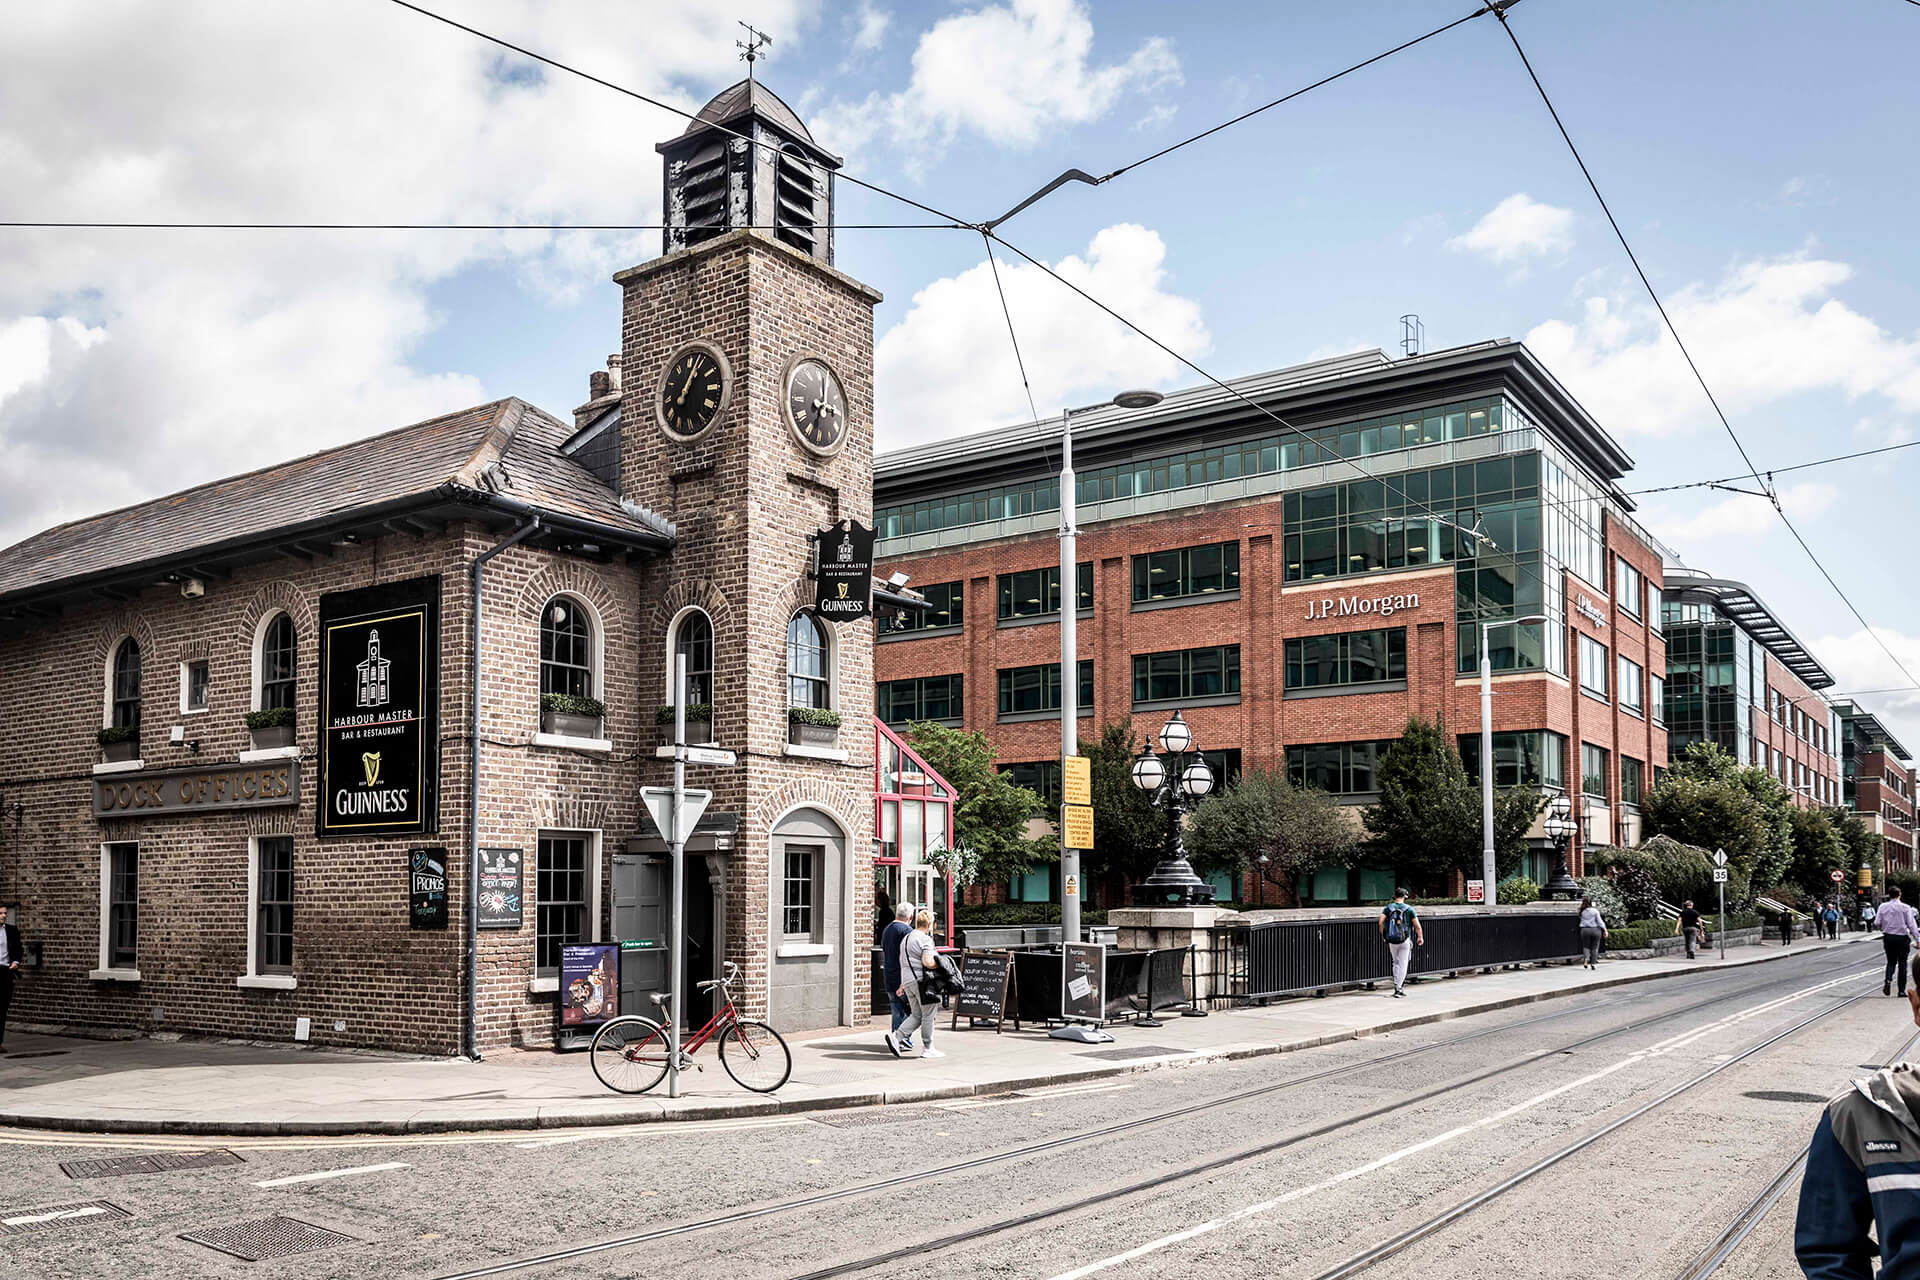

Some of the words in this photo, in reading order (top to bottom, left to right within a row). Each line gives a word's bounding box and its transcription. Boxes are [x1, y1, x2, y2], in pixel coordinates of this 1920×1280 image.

[821, 599, 864, 612] GUINNESS
[1304, 593, 1420, 620] J.P.Morgan
[334, 713, 375, 727] HARBOUR
[378, 709, 413, 722] MASTER
[341, 730, 354, 740] BAR
[356, 730, 361, 738] &
[363, 725, 405, 738] RESTAURANT
[102, 780, 164, 811] DOCK
[179, 768, 289, 804] OFFICES
[336, 788, 408, 815] GUINNESS
[416, 876, 445, 891] PROMOS
[1715, 871, 1727, 880] 35
